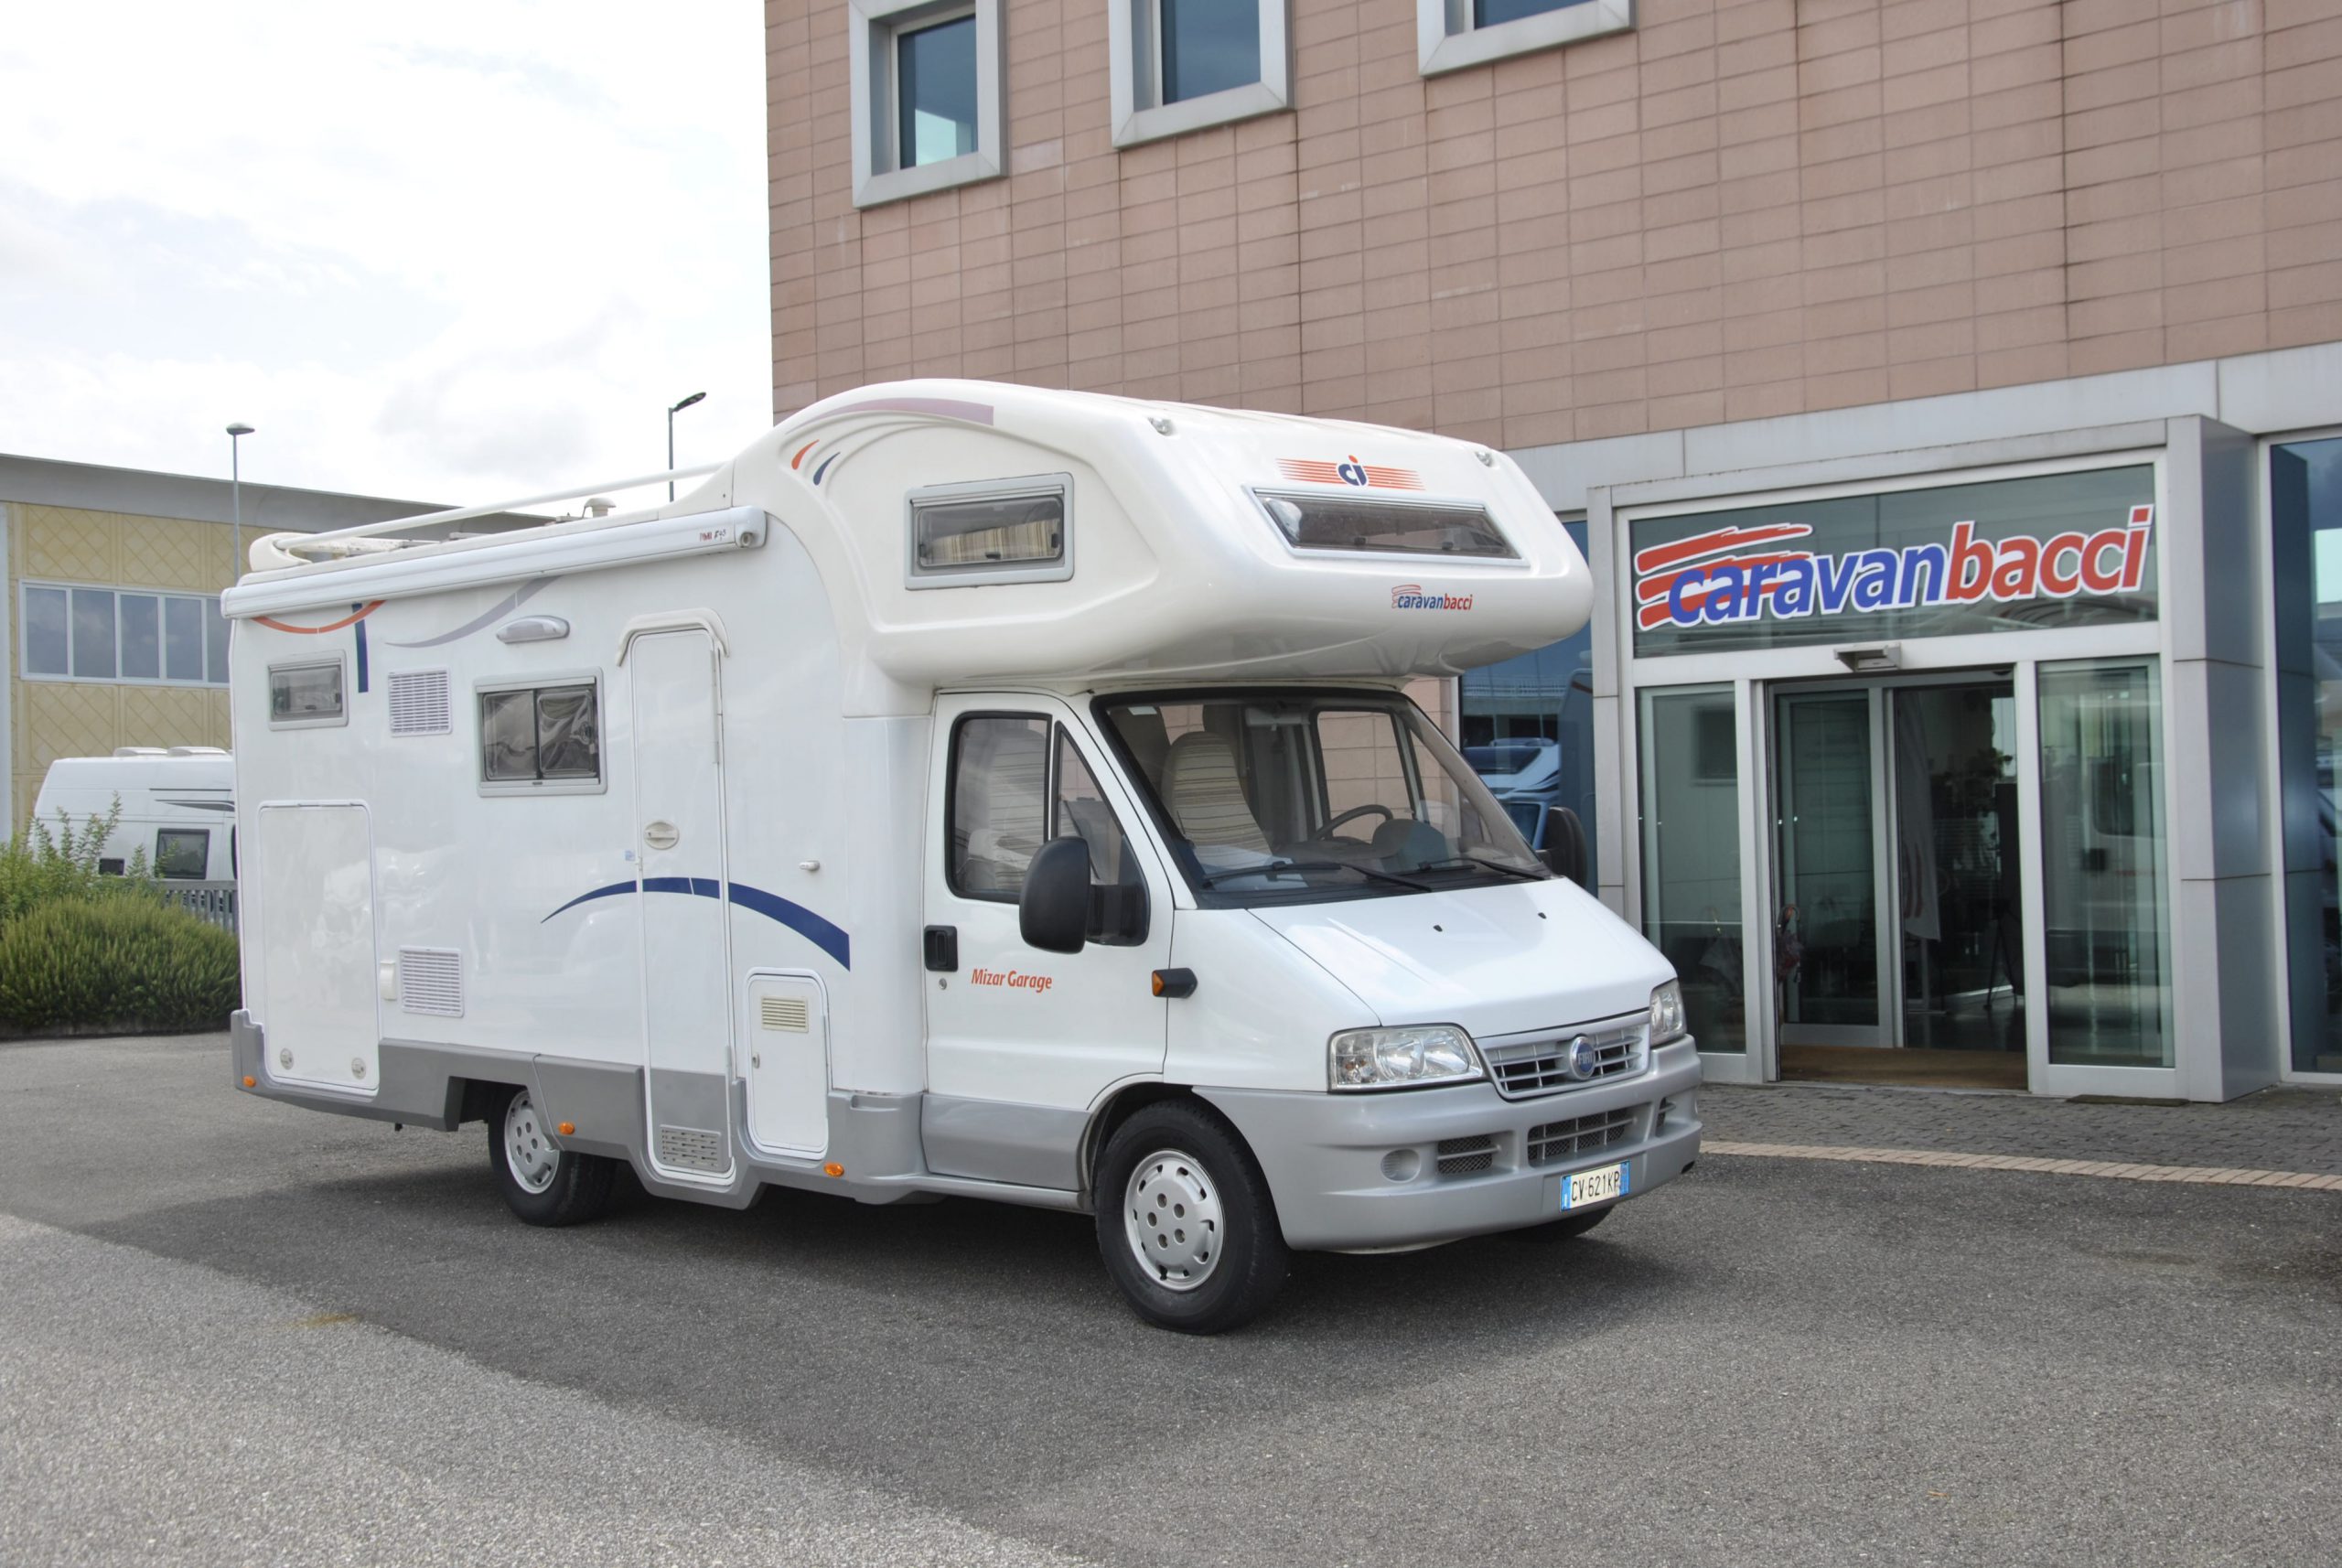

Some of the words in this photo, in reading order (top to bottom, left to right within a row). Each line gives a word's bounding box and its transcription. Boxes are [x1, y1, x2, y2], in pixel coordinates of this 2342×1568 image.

[1668, 504, 2154, 627] caravanbacci
[1397, 593, 1473, 610] caravanbacci
[971, 969, 1006, 986] Mizar
[1007, 970, 1052, 993] Garage
[1577, 1051, 1594, 1065] FIAT
[1572, 1179, 1585, 1201] CV
[1587, 1171, 1620, 1197] 621KP
